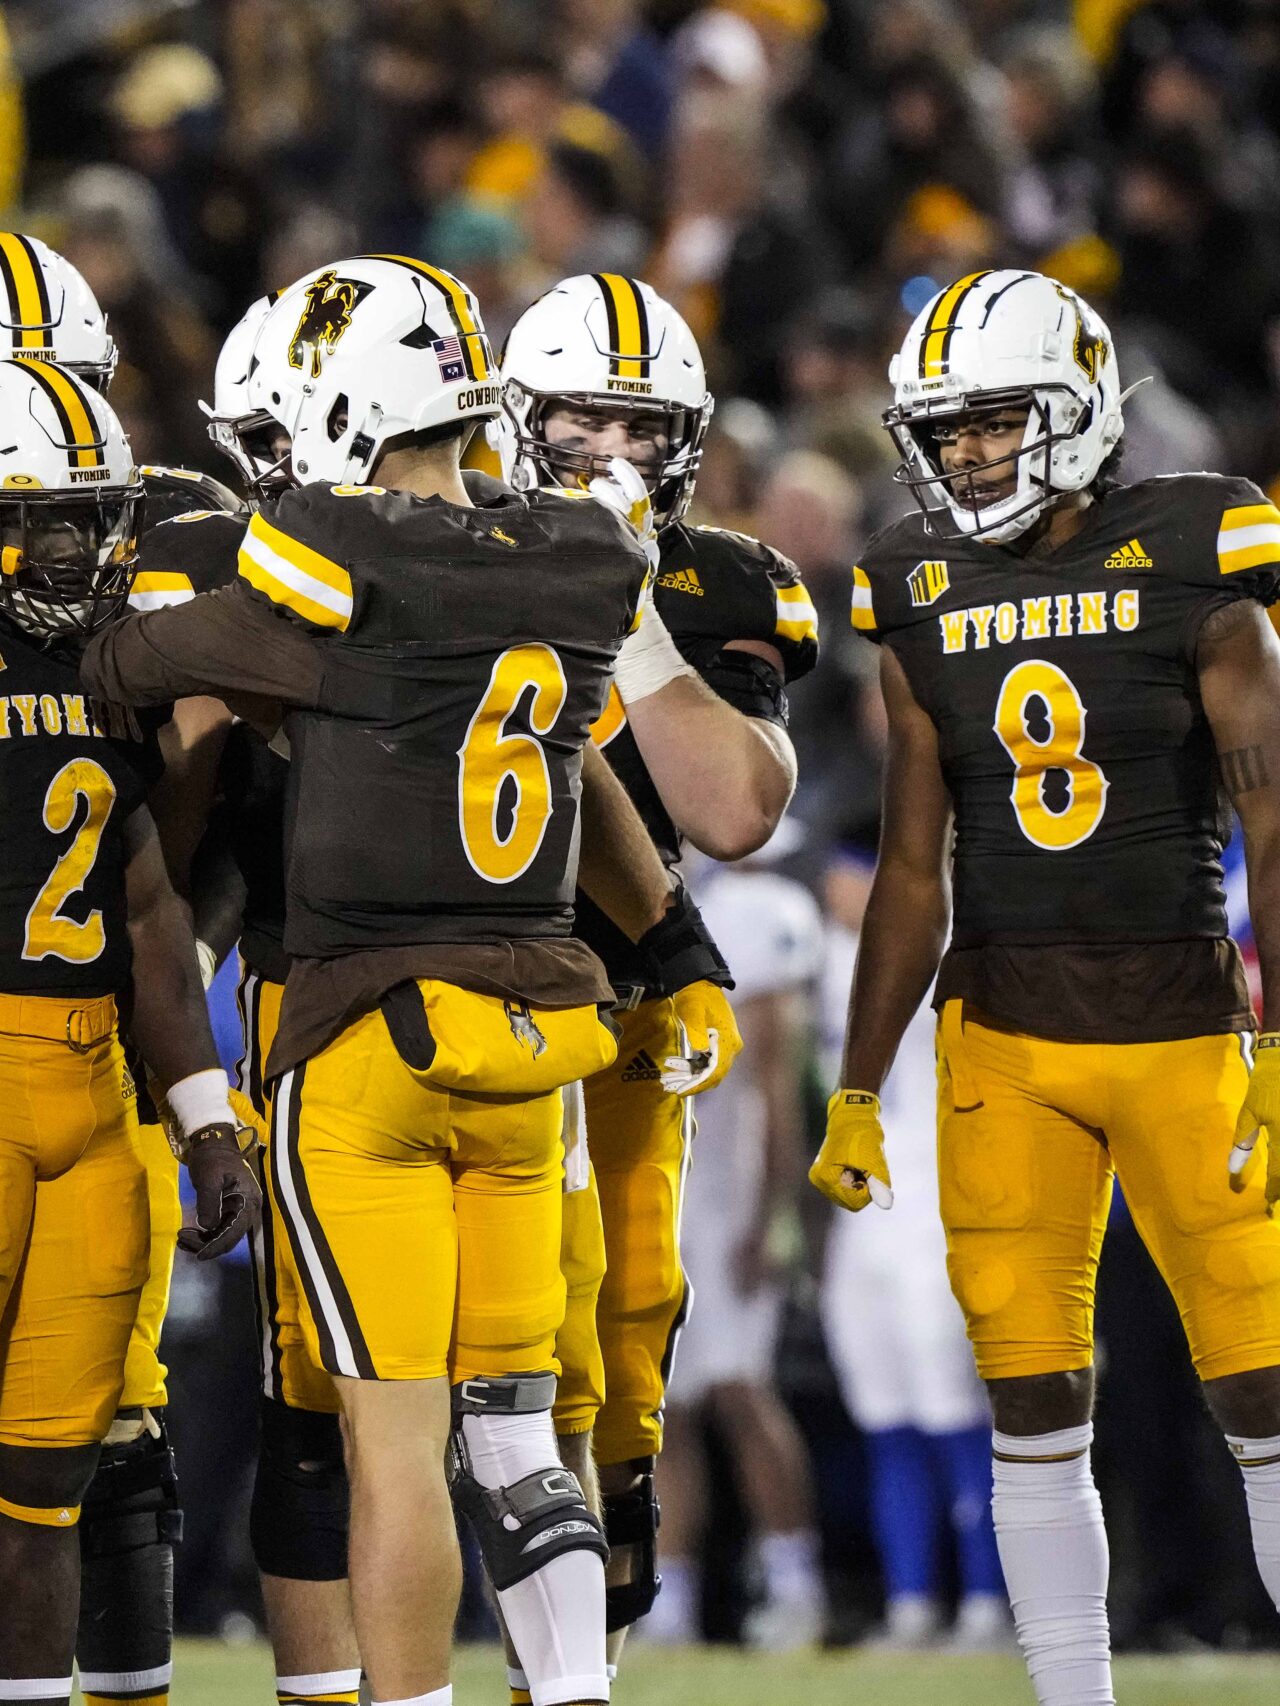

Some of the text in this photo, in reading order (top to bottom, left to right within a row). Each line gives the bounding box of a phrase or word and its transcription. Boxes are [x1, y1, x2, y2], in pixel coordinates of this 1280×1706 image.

[607, 379, 653, 394] WYOMING
[69, 469, 111, 483] WYOMING
[1104, 556, 1154, 569] adidas
[657, 576, 705, 597] adidas
[939, 589, 1139, 654] WYOMING
[457, 643, 568, 884] 6
[992, 659, 1111, 851] 8
[21, 757, 117, 964] 2
[540, 1523, 591, 1540] DONJOY
